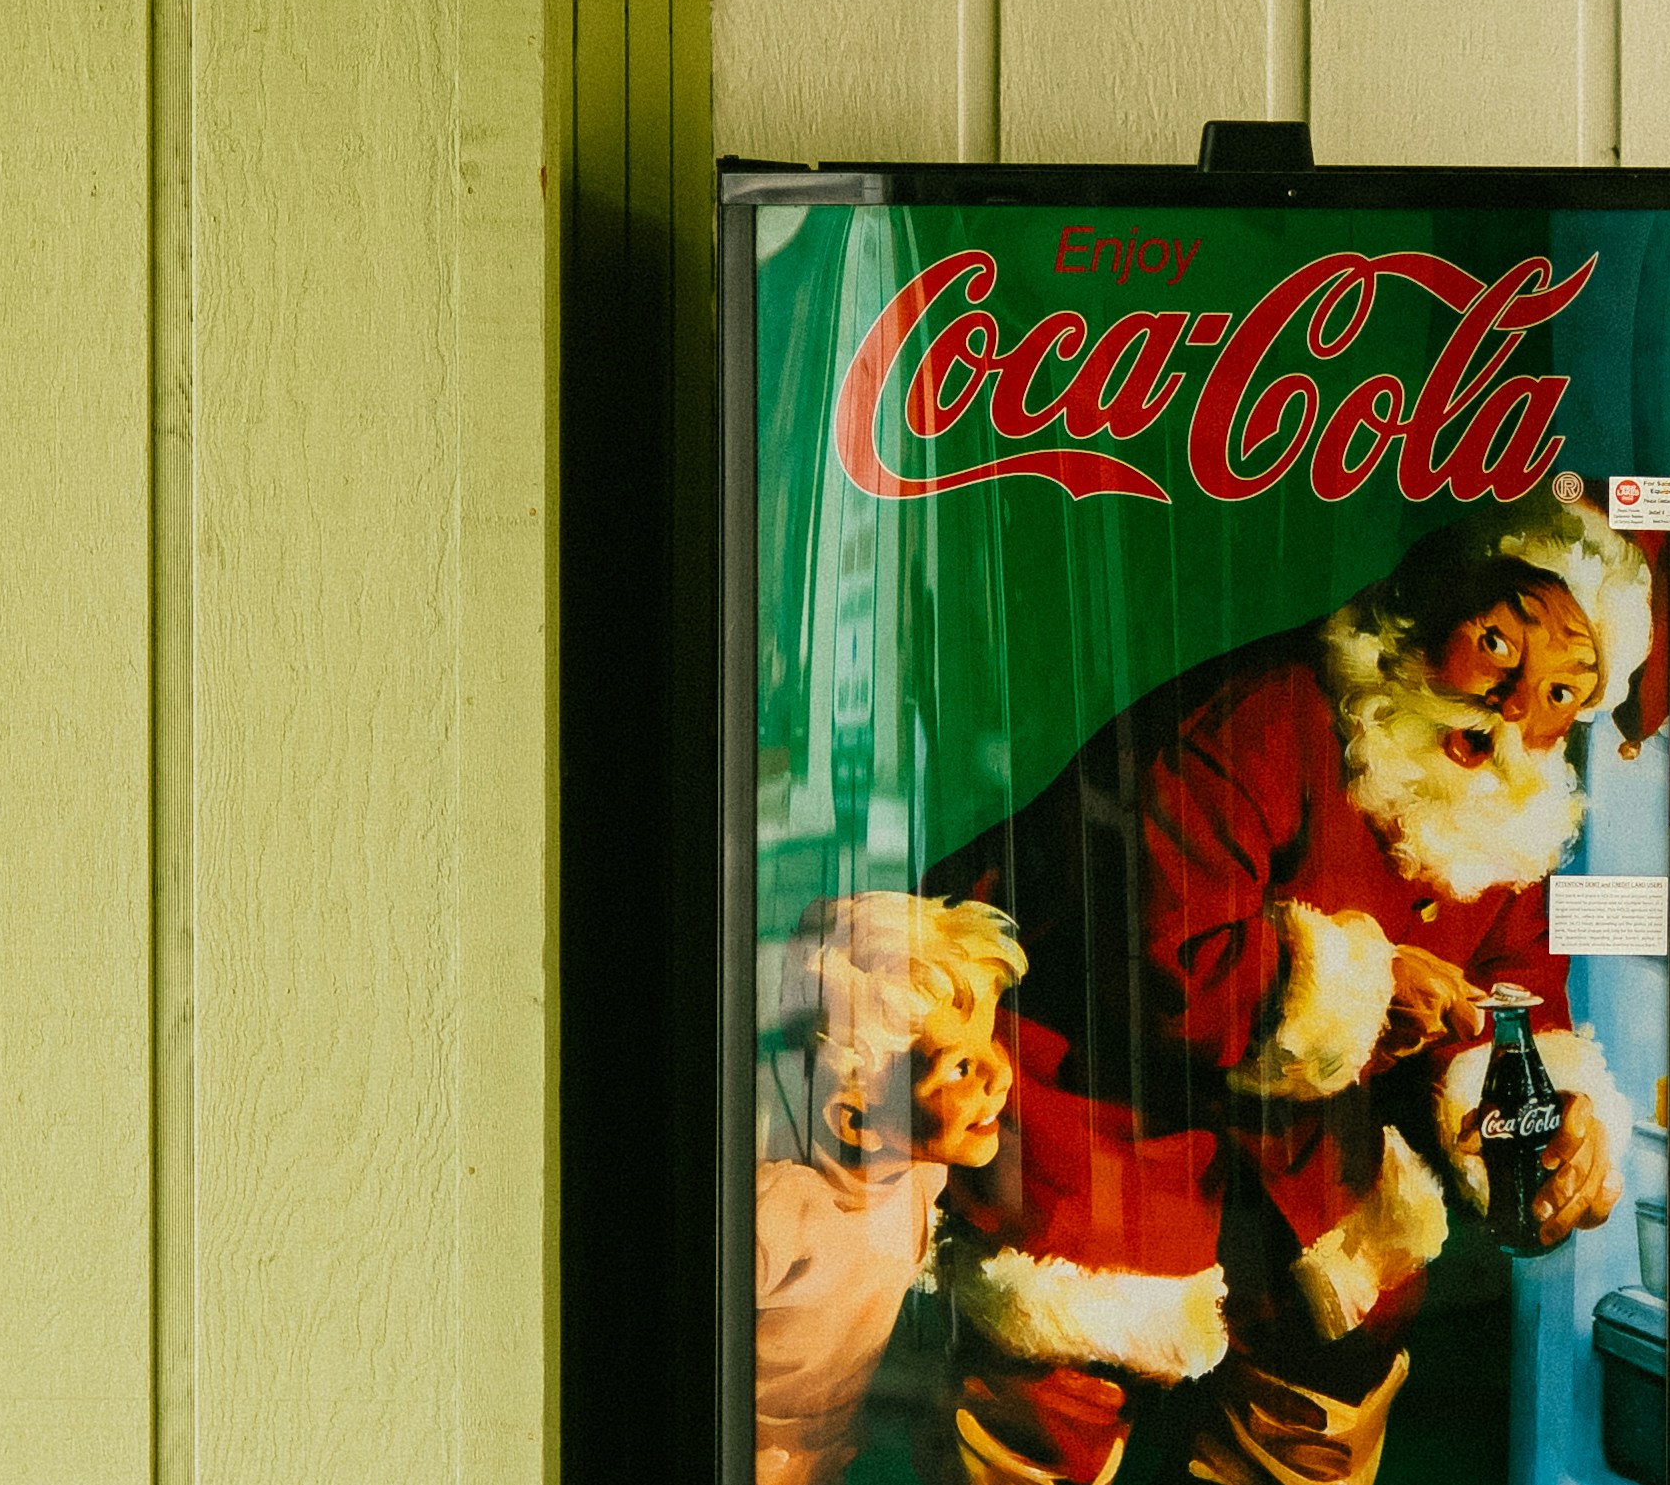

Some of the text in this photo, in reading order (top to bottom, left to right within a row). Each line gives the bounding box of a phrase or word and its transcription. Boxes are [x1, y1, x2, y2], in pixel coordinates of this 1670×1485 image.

[1054, 225, 1202, 285] Enjoy
[834, 250, 1599, 504] Coca-Cola
[1481, 1104, 1561, 1139] Coca-Cola
